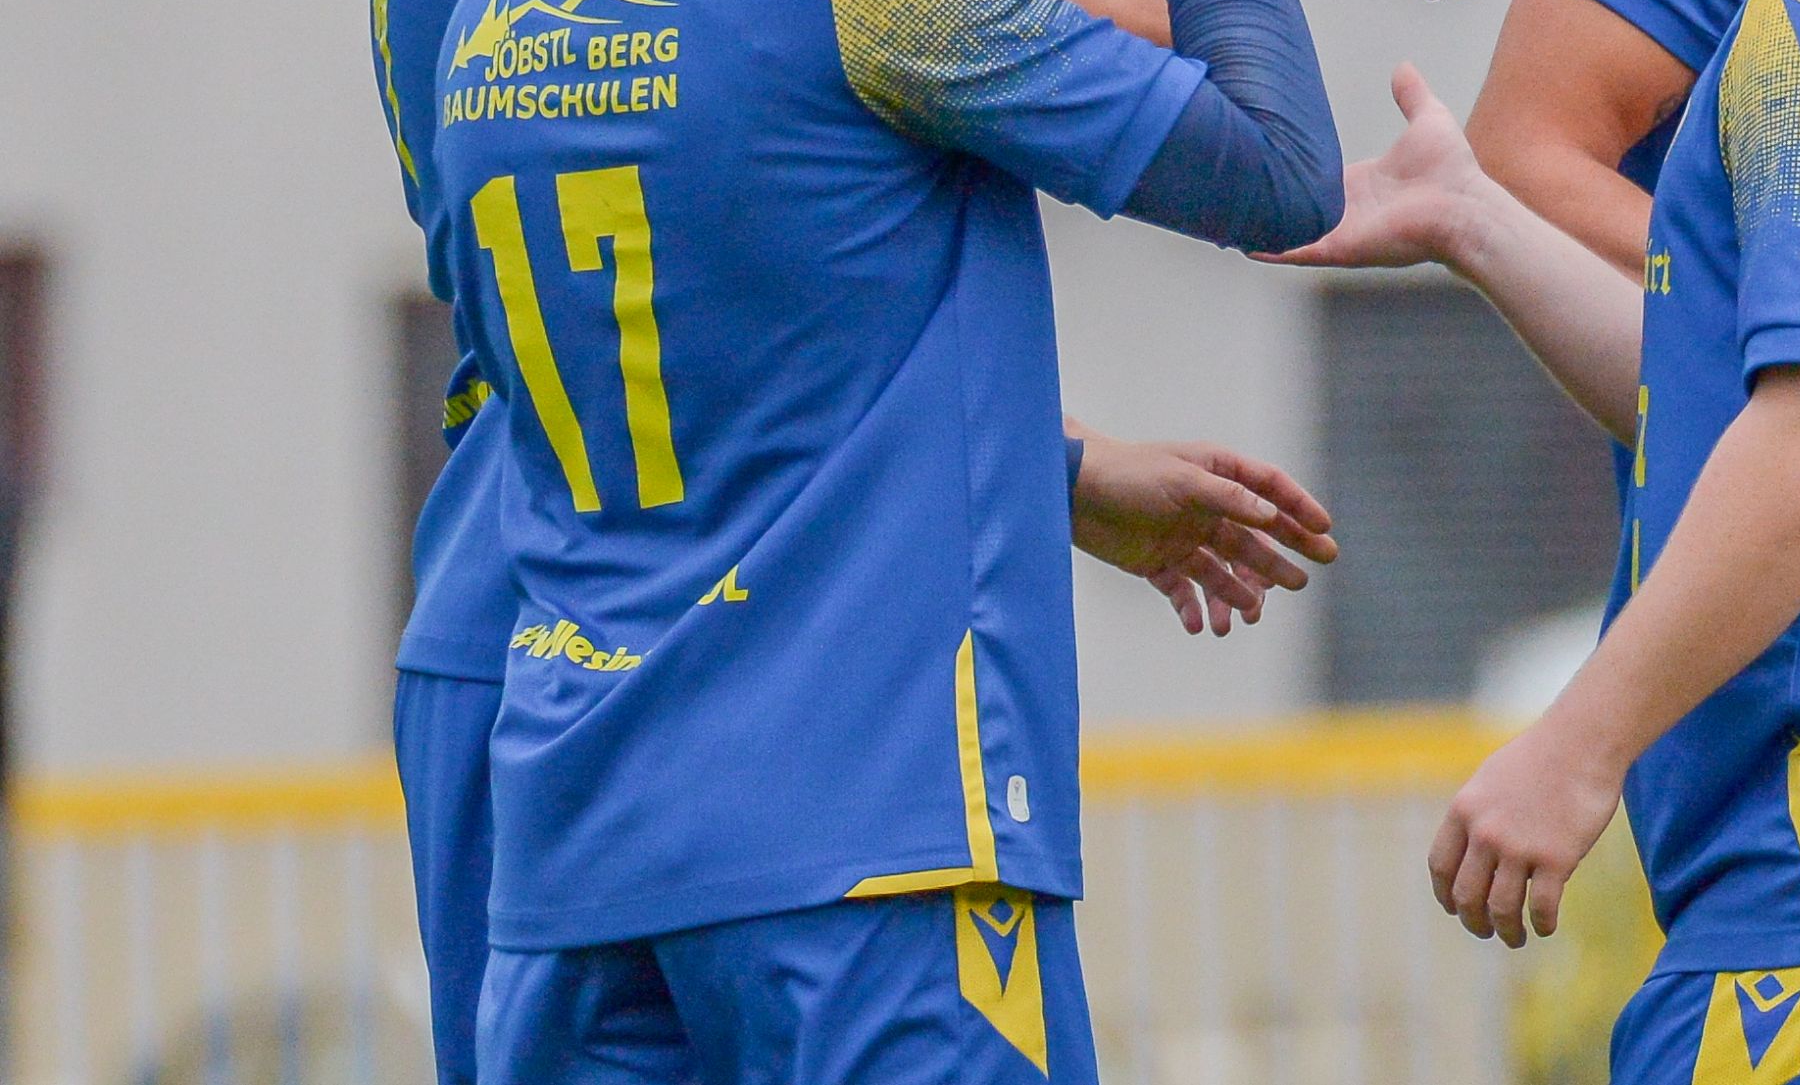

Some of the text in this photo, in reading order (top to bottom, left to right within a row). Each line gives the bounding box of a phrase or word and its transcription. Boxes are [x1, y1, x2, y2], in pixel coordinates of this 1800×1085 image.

[485, 27, 679, 82] JÖBSTL BERG
[443, 74, 678, 129] BAUMSCHULEN
[470, 165, 684, 512] 17
